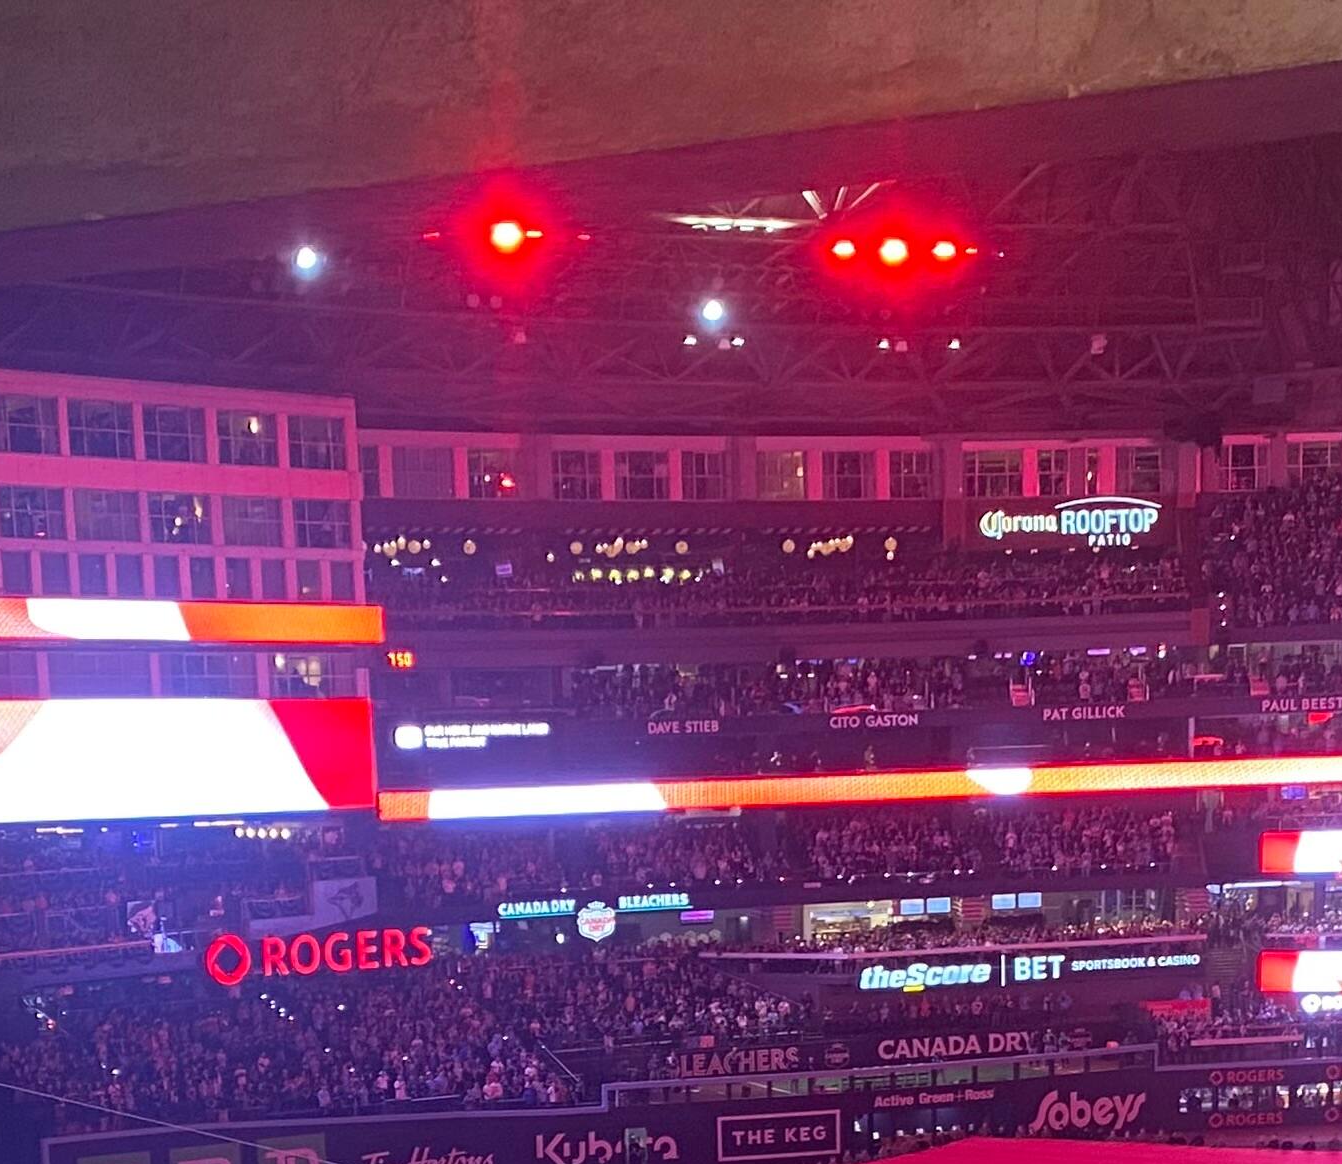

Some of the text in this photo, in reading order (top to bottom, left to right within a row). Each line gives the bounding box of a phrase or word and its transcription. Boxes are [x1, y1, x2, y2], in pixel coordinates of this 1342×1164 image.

[979, 508, 1159, 540] Corona ROOFTOP
[1088, 534, 1132, 547] PATIO
[1042, 705, 1126, 721] PAT GILLICK
[1261, 699, 1297, 713] PAUL
[647, 720, 720, 735] DAVE STIEB
[829, 714, 919, 729] CITO GASTON
[497, 899, 576, 916] CANADA DRY
[618, 894, 690, 909] BLEACHERS
[261, 926, 435, 977] ROGERS
[859, 954, 1201, 990] theScore BET SPORTSBOOK & CASINO
[877, 1033, 982, 1060] CANADA
[988, 1031, 1037, 1053] DRY
[672, 1047, 799, 1078] LEACHERS
[1226, 1068, 1285, 1085] ROGERS
[874, 1095, 914, 1108] Active
[1029, 1090, 1146, 1131] Sobeys
[1225, 1111, 1284, 1128] ROGERS
[732, 1126, 828, 1146] THE KEG
